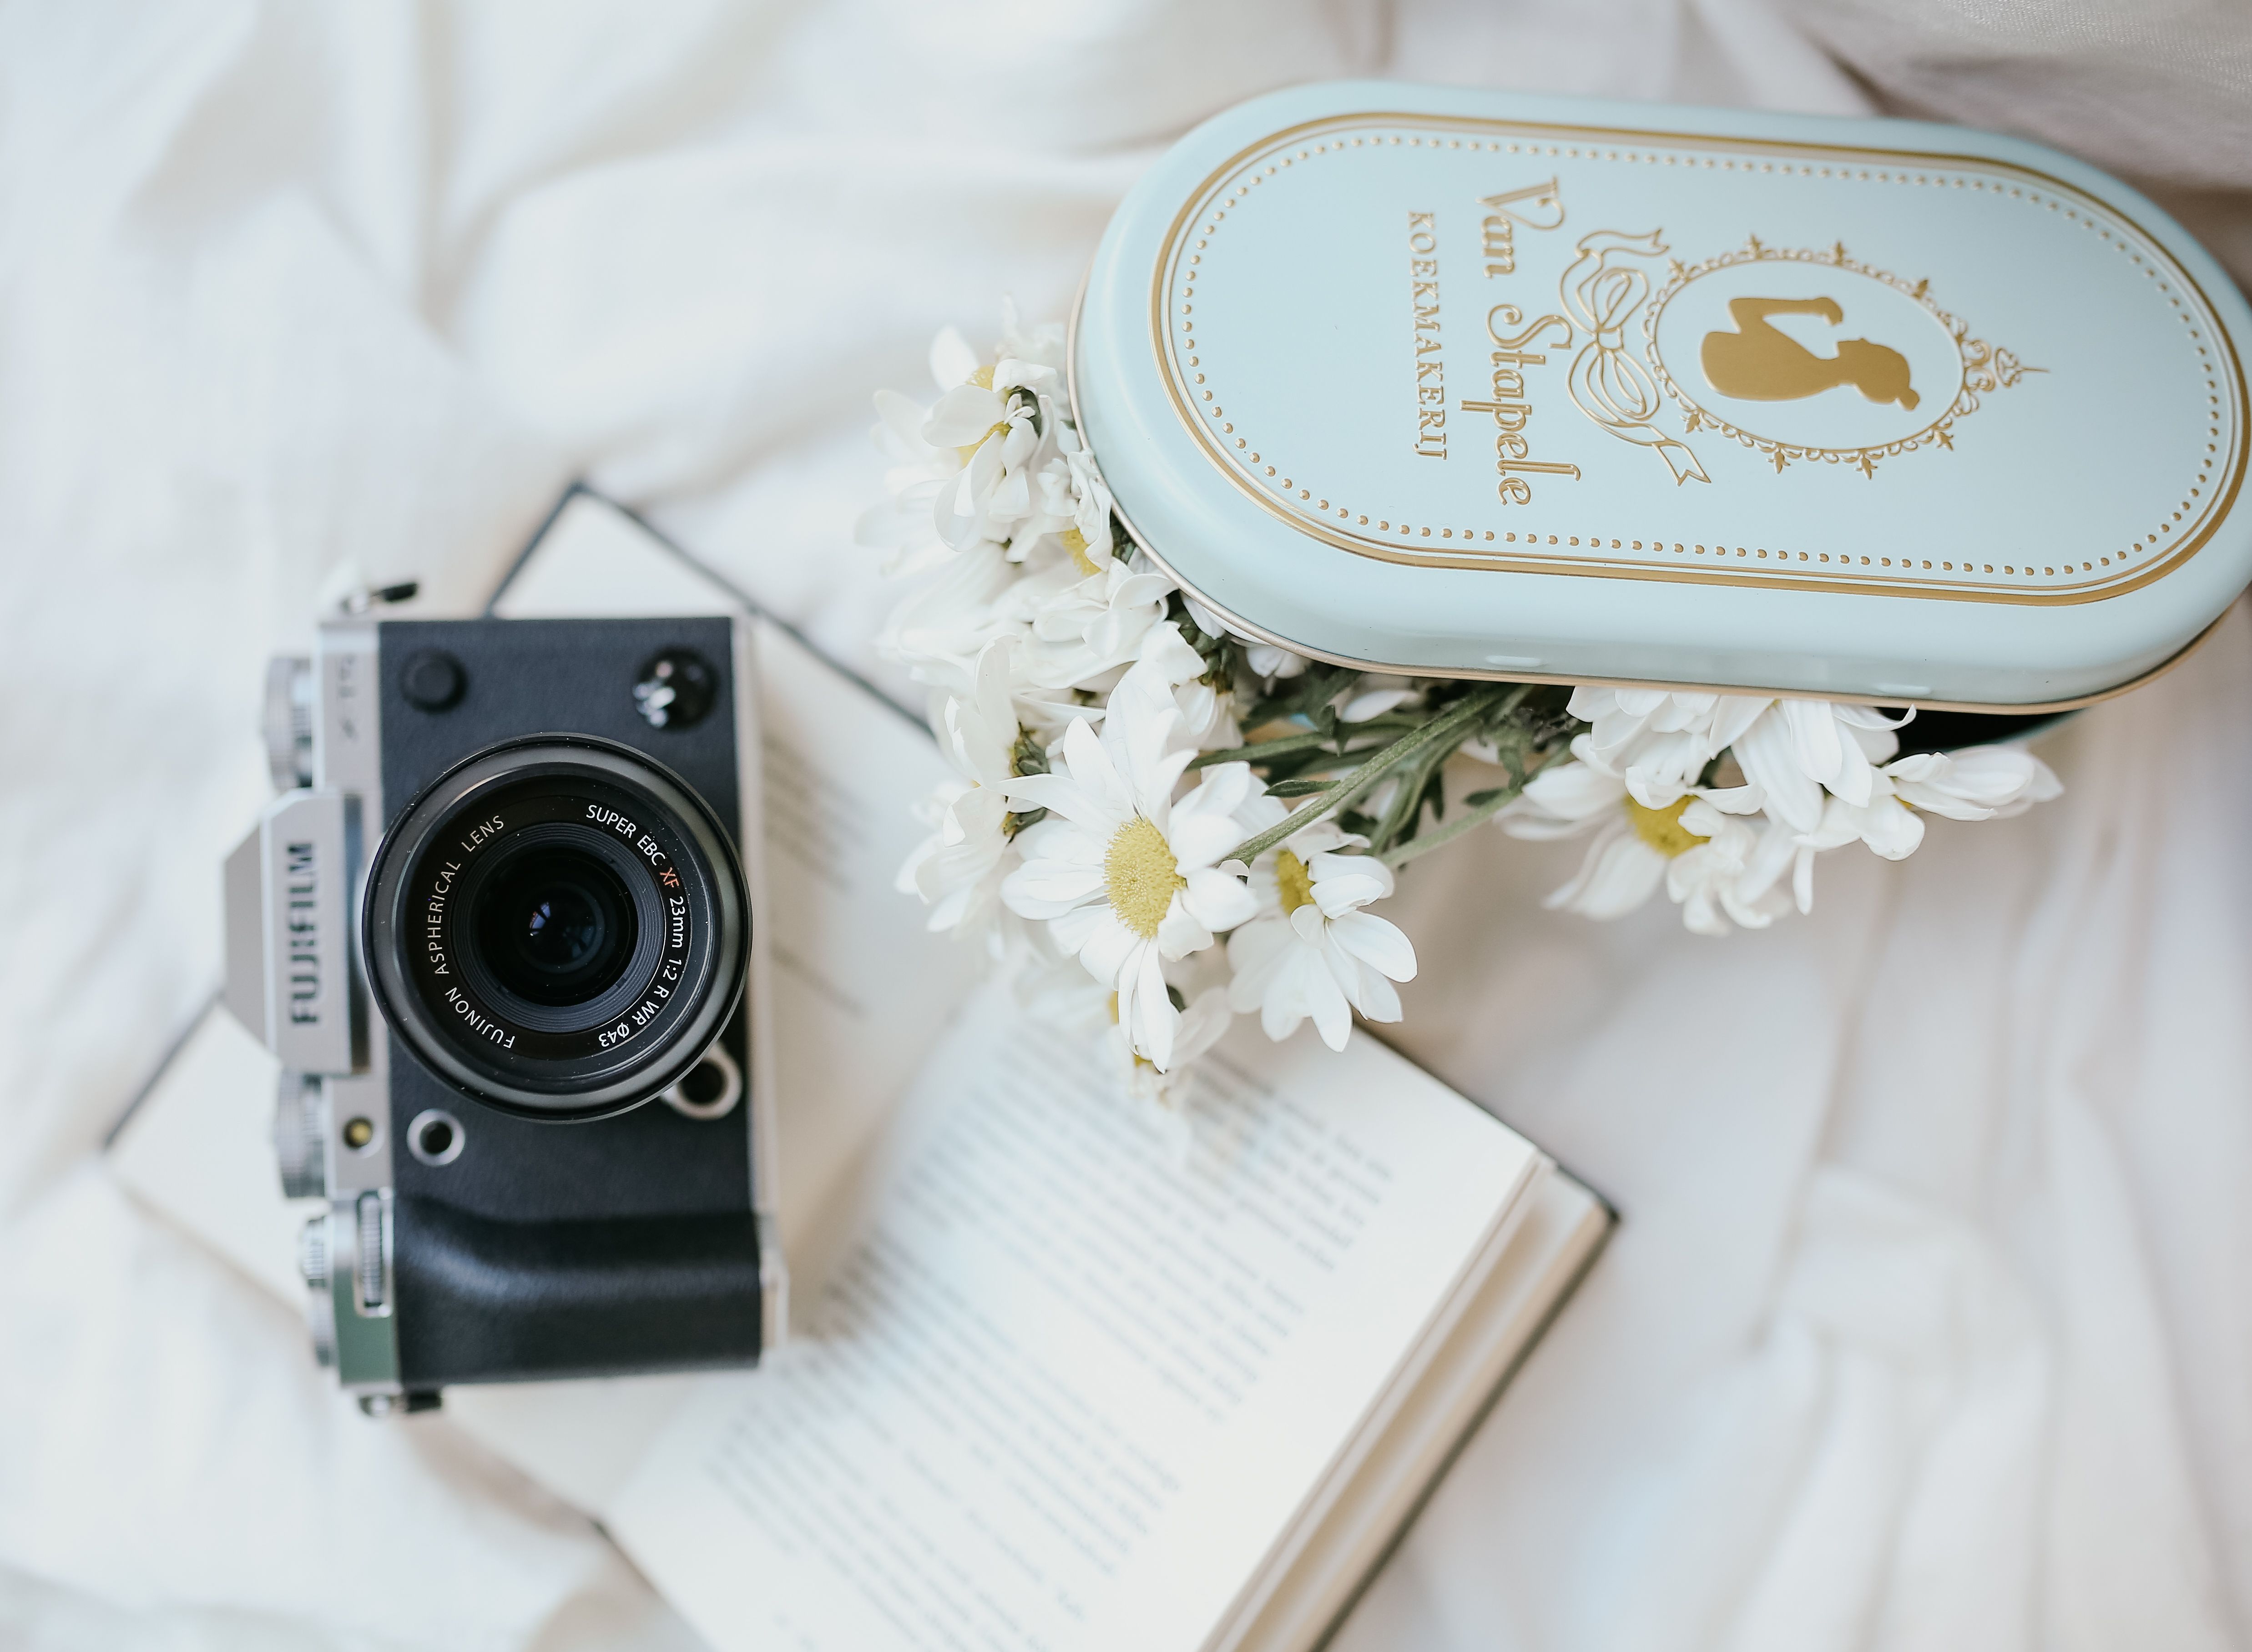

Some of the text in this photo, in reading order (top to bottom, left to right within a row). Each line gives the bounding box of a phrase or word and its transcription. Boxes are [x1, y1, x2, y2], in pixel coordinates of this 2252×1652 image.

[1407, 211, 1447, 460] KOEKMAKERIJ
[1459, 176, 1581, 506] Van Stapele
[288, 843, 318, 1023] FUJIFILM
[428, 816, 515, 1048] FUJINON ASPHERICAL LENS
[587, 806, 685, 1047] SUPER EBC XF 23mm 1:2 R WR Ø43
